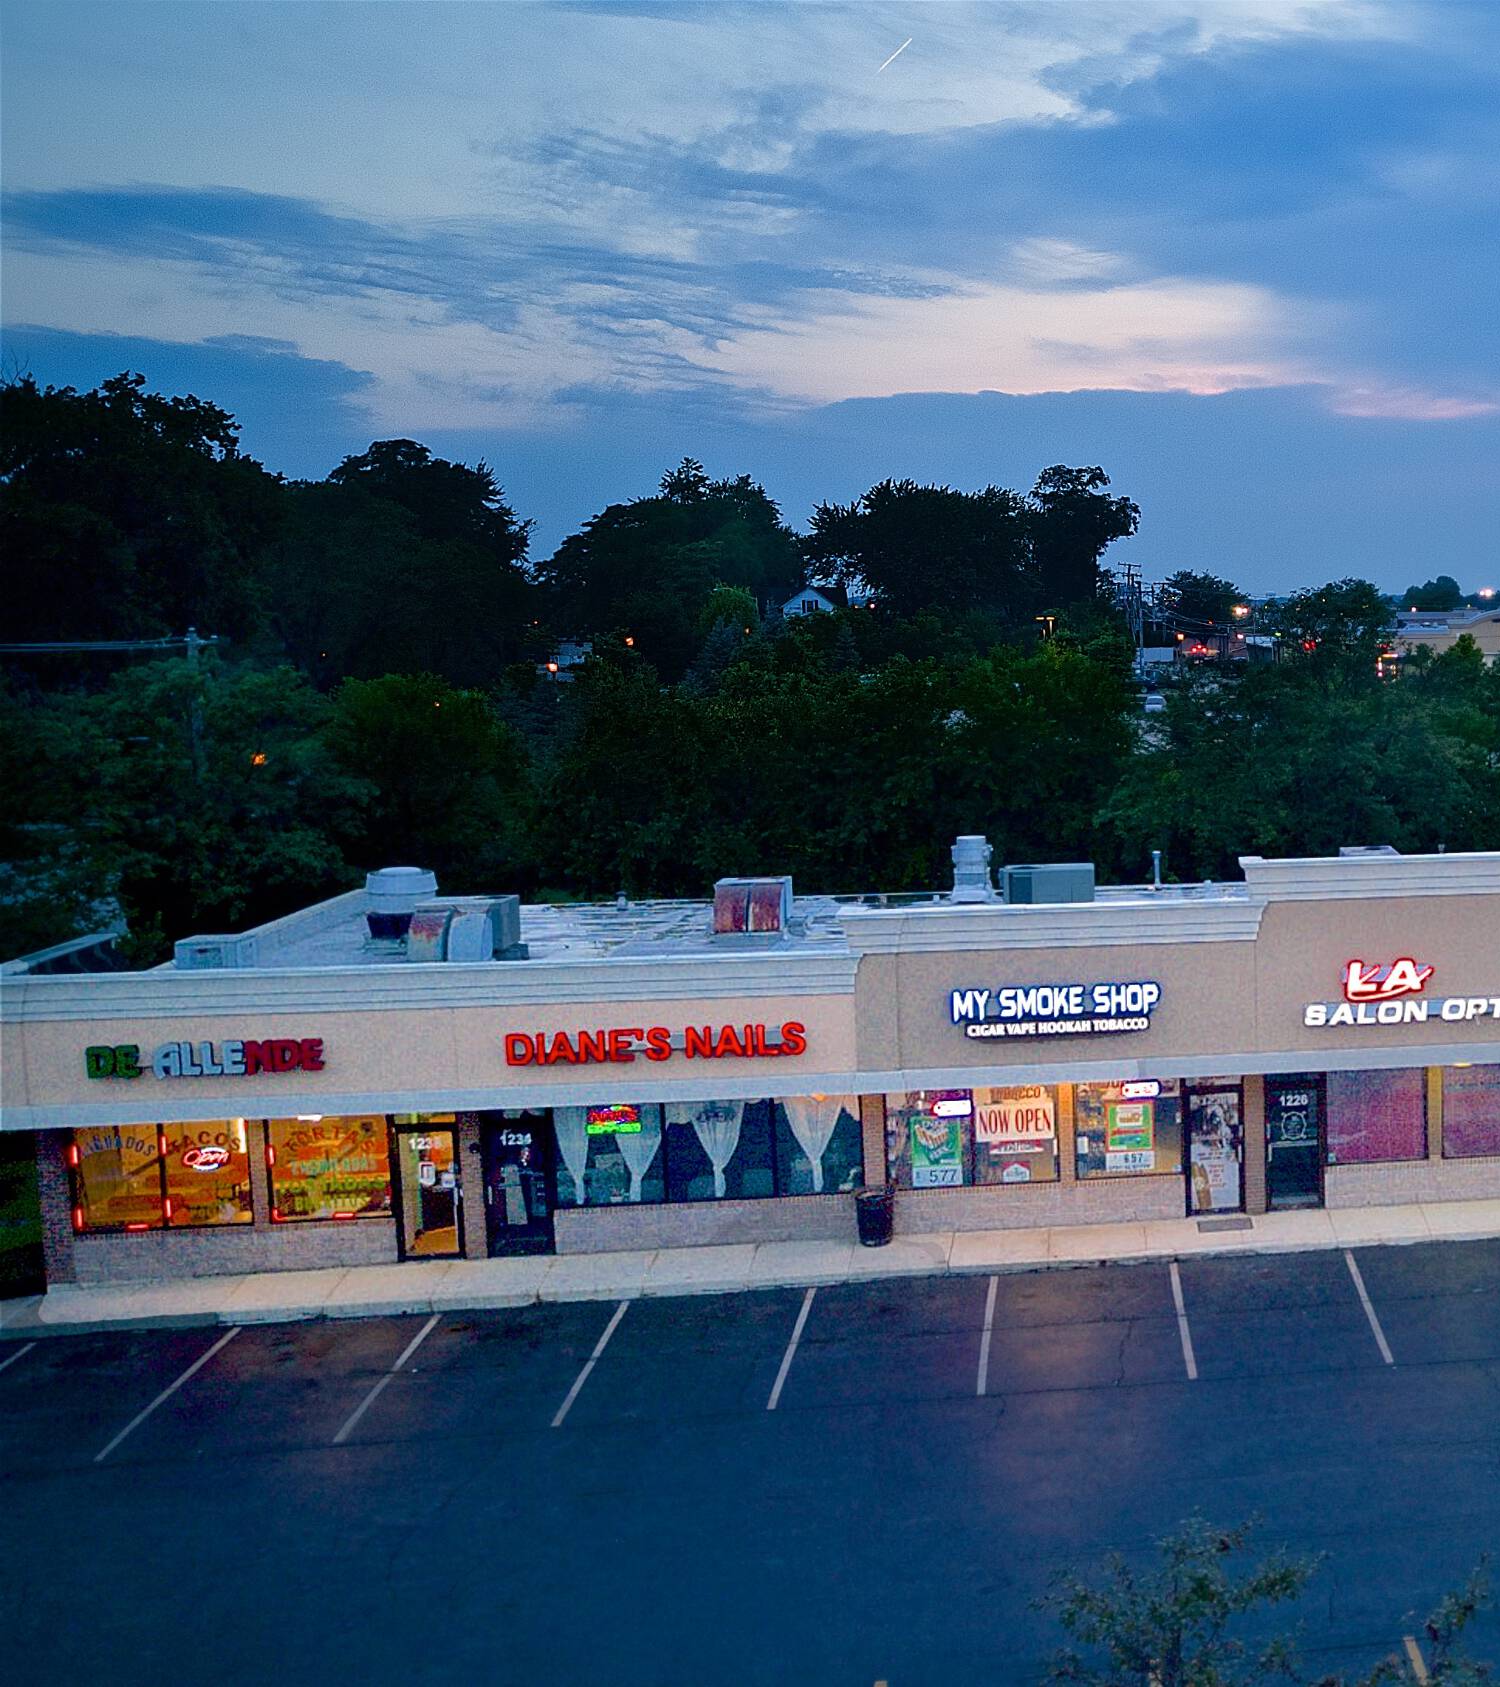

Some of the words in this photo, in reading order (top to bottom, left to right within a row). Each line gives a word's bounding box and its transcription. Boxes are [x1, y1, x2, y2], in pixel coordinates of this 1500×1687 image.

[952, 990, 989, 1022] MY
[999, 985, 1085, 1020] SMOKE
[1093, 983, 1160, 1016] SHOP
[1304, 999, 1427, 1026] SALON
[967, 1024, 1004, 1037] CIGAR
[1006, 1022, 1036, 1035] VAPE
[1038, 1020, 1091, 1033] HOOKAH
[1093, 1017, 1149, 1031] TOBACCO
[505, 1028, 671, 1066] DIANE'S
[685, 1022, 806, 1058] NAILS
[86, 1045, 142, 1079] DE
[153, 1038, 325, 1080] ALLENDE
[979, 1109, 1009, 1135] NOW
[1015, 1106, 1052, 1134] OPEN
[929, 1168, 958, 1183] 577
